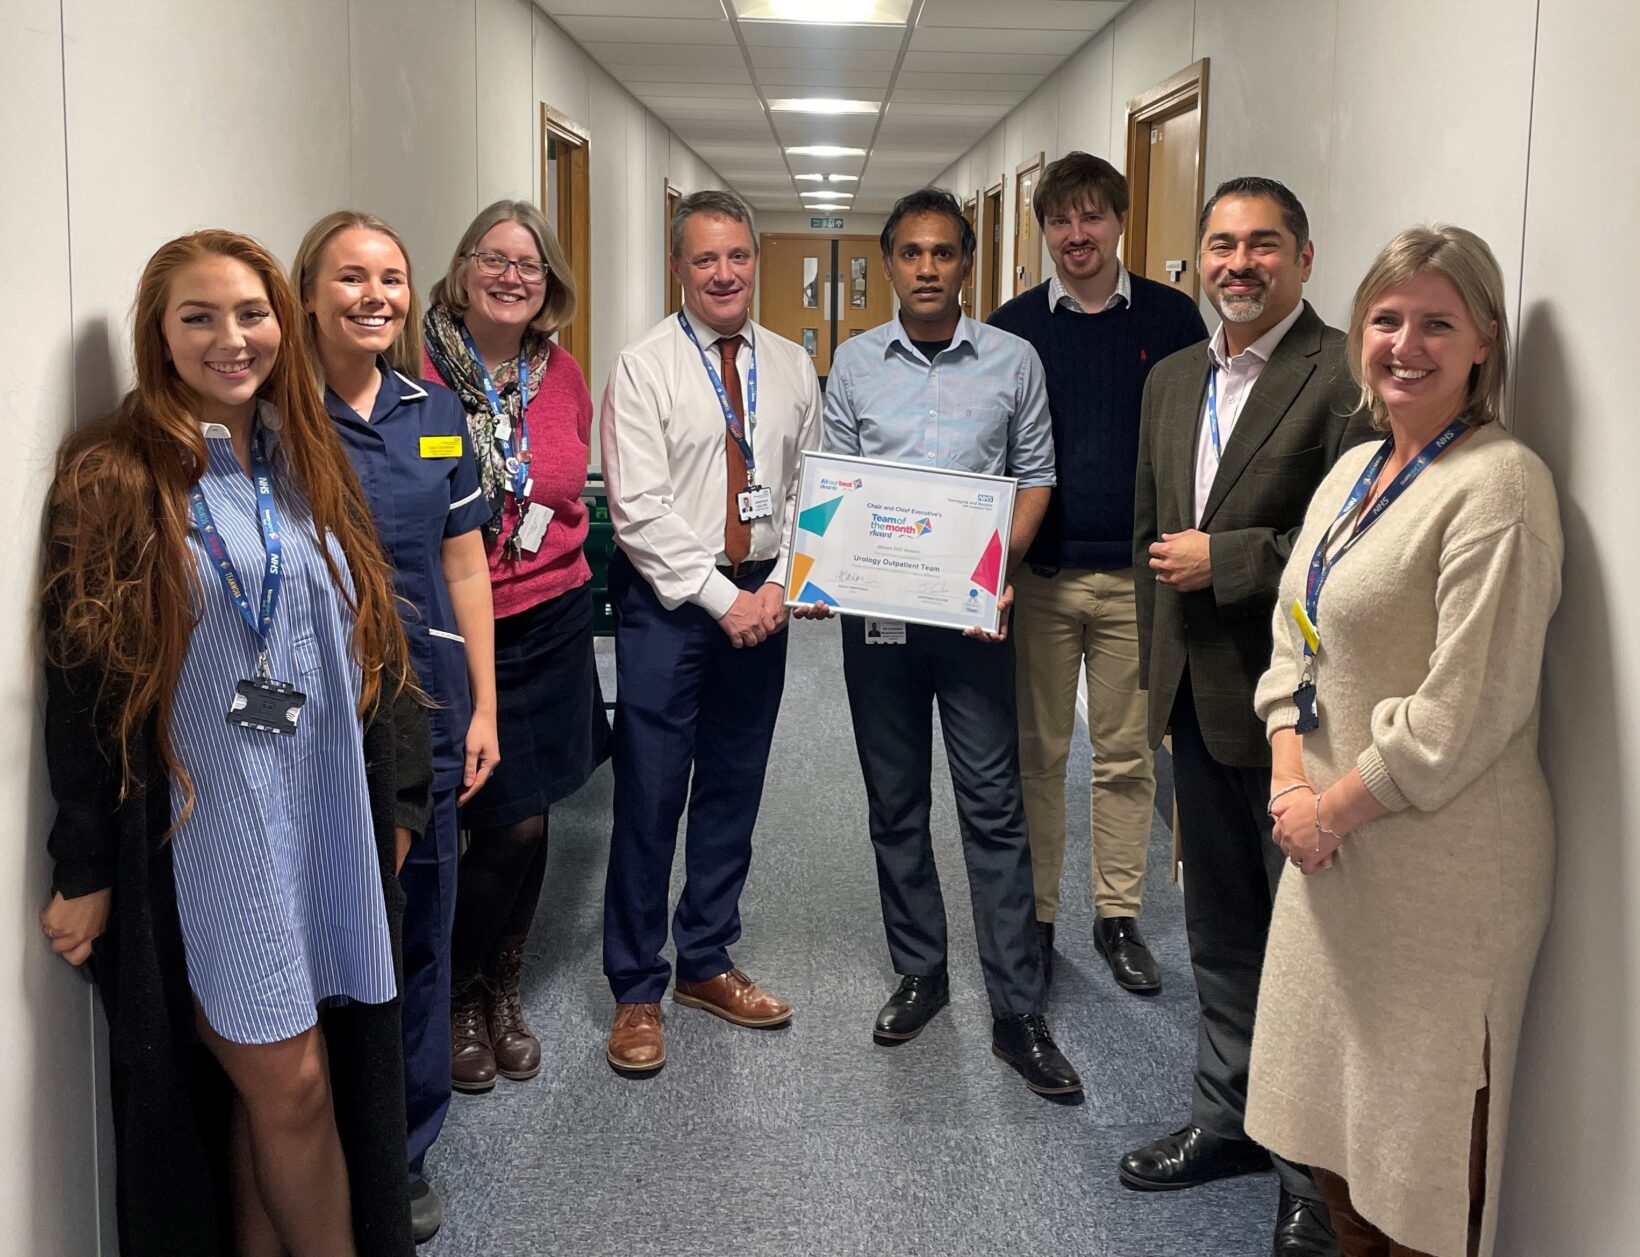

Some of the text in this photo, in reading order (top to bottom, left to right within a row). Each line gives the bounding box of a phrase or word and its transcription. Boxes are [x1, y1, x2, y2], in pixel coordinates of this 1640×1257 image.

[1435, 429, 1455, 448] NHS
[258, 477, 269, 495] NHS
[977, 493, 993, 503] NHS
[1372, 496, 1390, 515] NHS
[867, 502, 882, 510] Chair
[911, 508, 943, 518] Executive's
[869, 529, 893, 539] Award
[269, 553, 279, 575] NHS
[853, 555, 881, 566] Urology
[882, 558, 919, 570] Outpatient
[920, 563, 940, 573] Team
